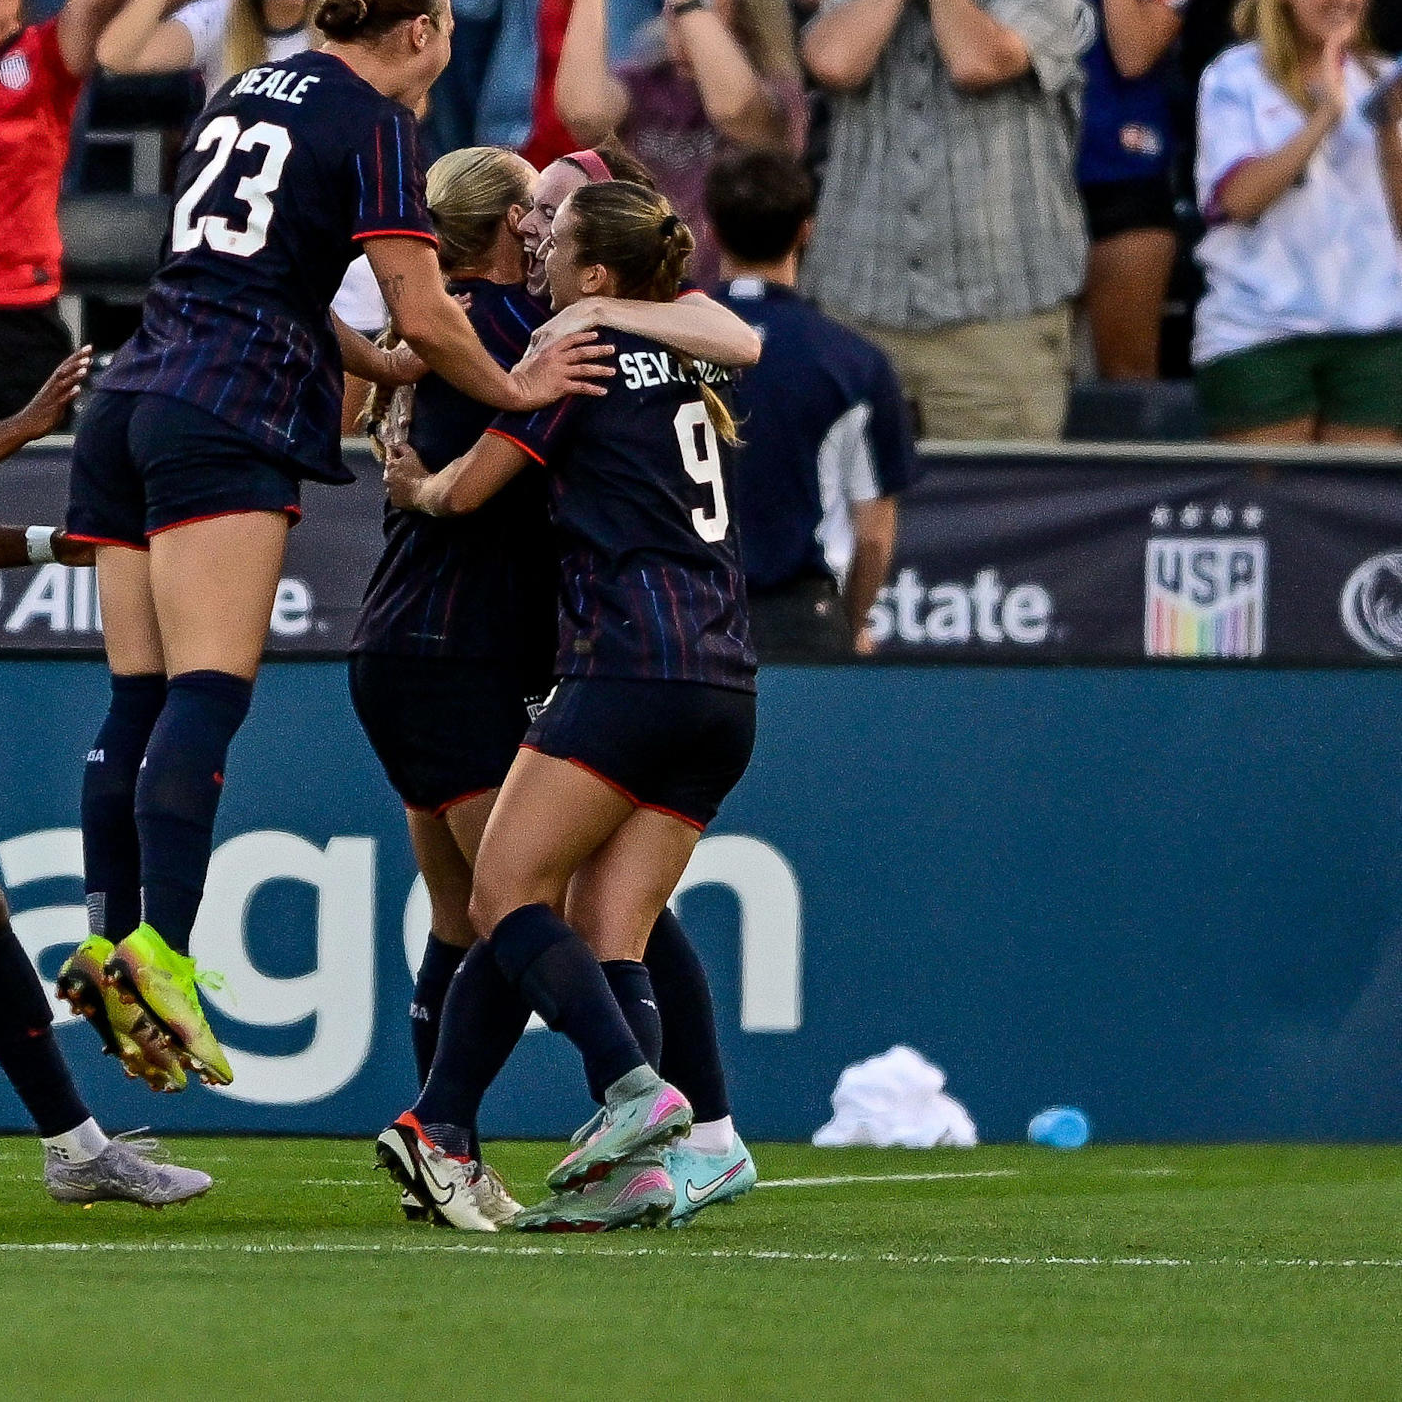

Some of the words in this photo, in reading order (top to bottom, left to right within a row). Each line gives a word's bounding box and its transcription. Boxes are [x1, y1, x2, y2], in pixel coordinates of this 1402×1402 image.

[173, 115, 292, 258] 23
[673, 401, 730, 543] 9
[1156, 551, 1256, 605] USA
